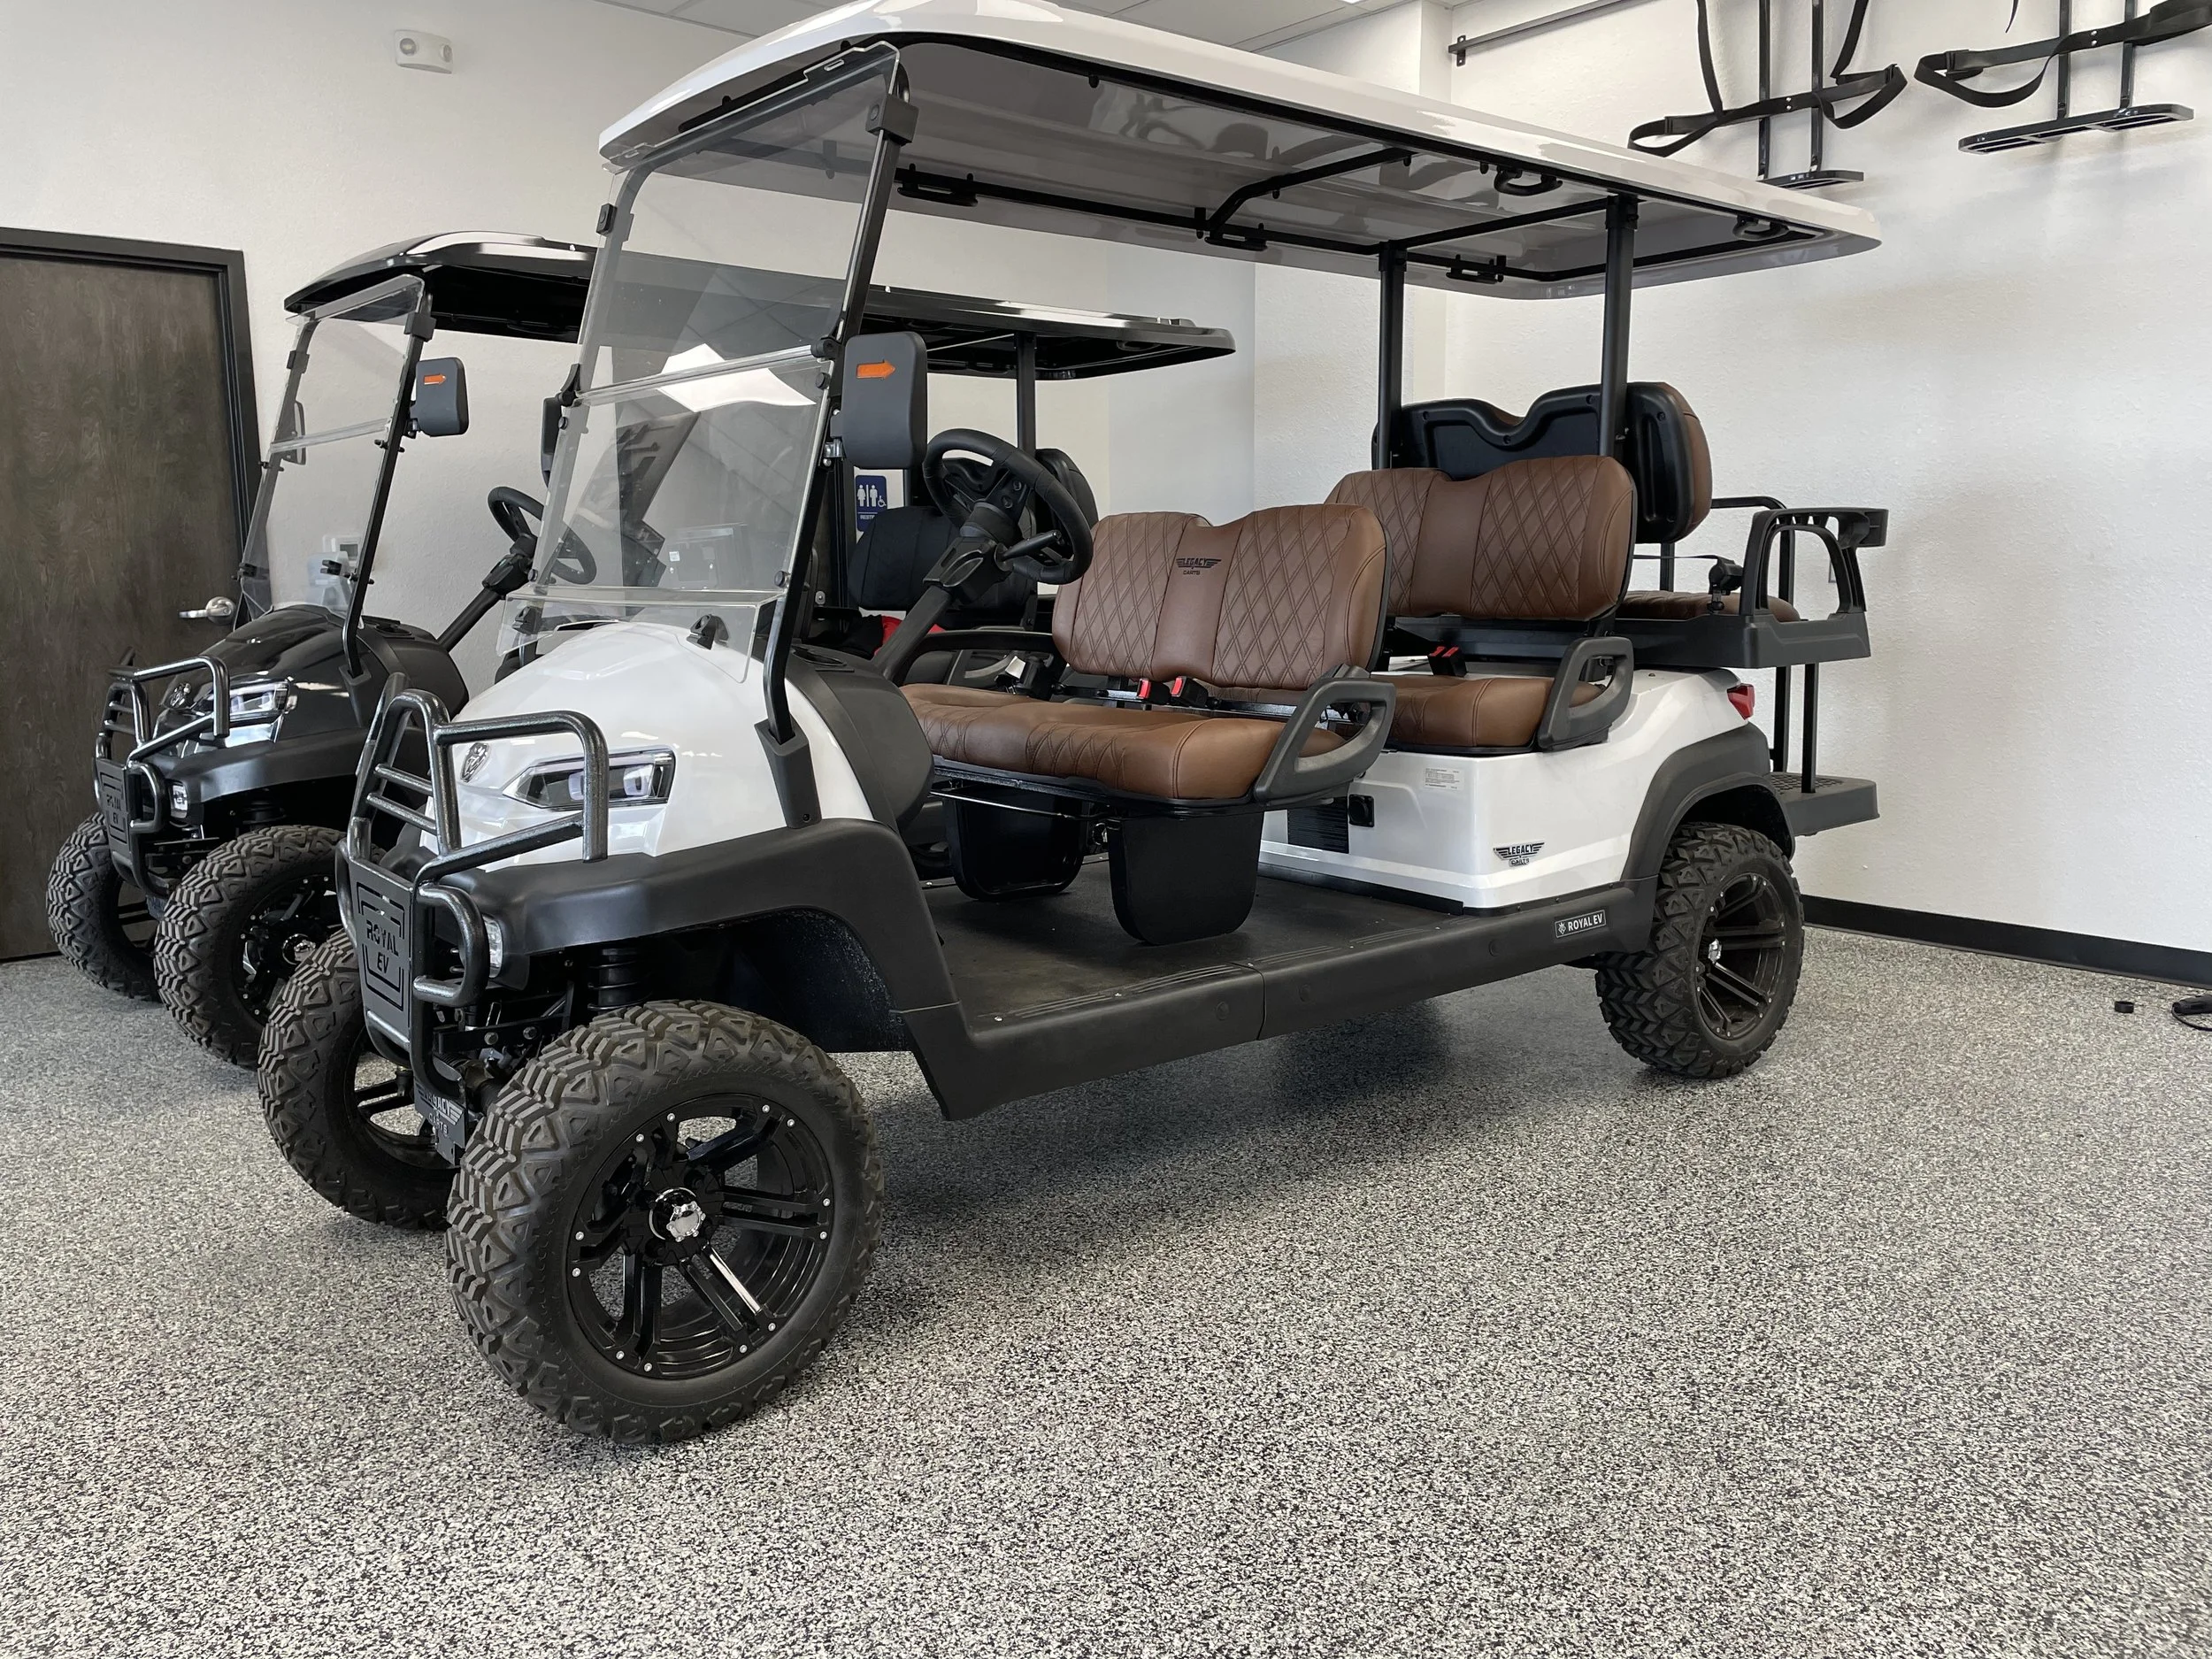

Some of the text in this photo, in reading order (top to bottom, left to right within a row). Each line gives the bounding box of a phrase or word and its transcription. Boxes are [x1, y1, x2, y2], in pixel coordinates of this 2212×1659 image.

[1183, 557, 1207, 566] LEGACY
[1508, 844, 1533, 855] LEGACY
[1567, 913, 1602, 932] ROYAL EV
[366, 919, 399, 956] ROYAL
[377, 951, 389, 974] EV
